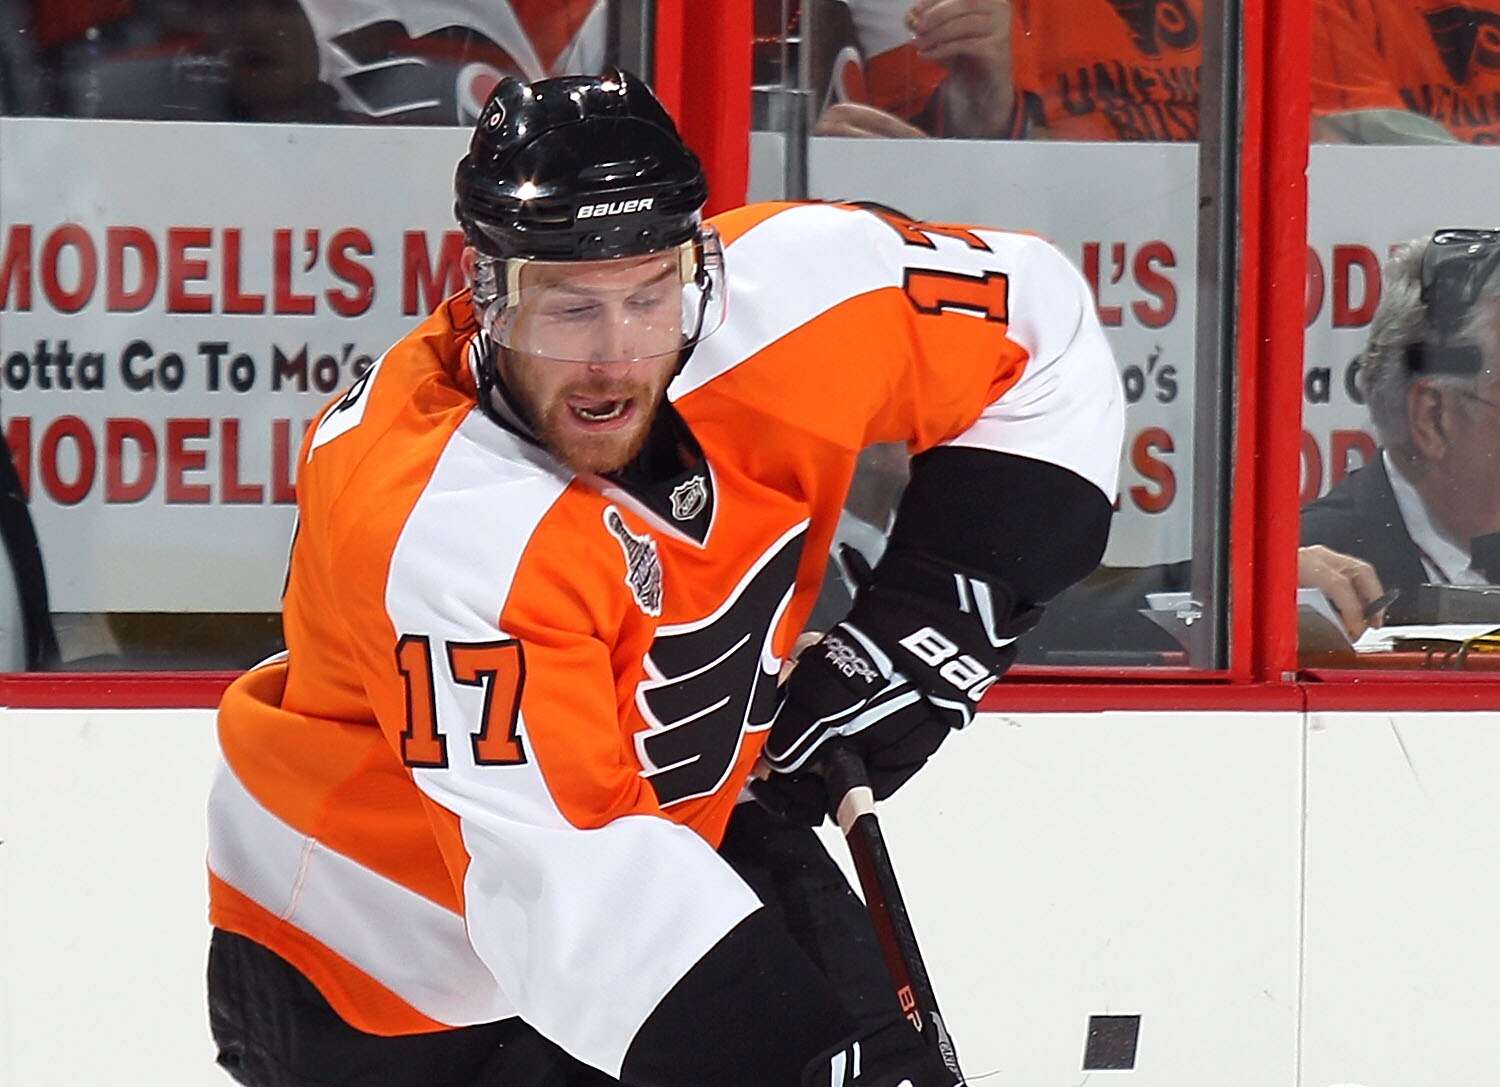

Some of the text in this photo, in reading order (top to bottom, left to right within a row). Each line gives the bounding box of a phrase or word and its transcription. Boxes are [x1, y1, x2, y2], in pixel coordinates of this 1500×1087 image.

[576, 197, 655, 219] BAUER
[0, 338, 105, 391] otta
[119, 339, 185, 392] Go
[198, 341, 256, 393] To
[1122, 350, 1178, 404] o's
[5, 414, 315, 506] ODELL
[396, 633, 528, 769] 17
